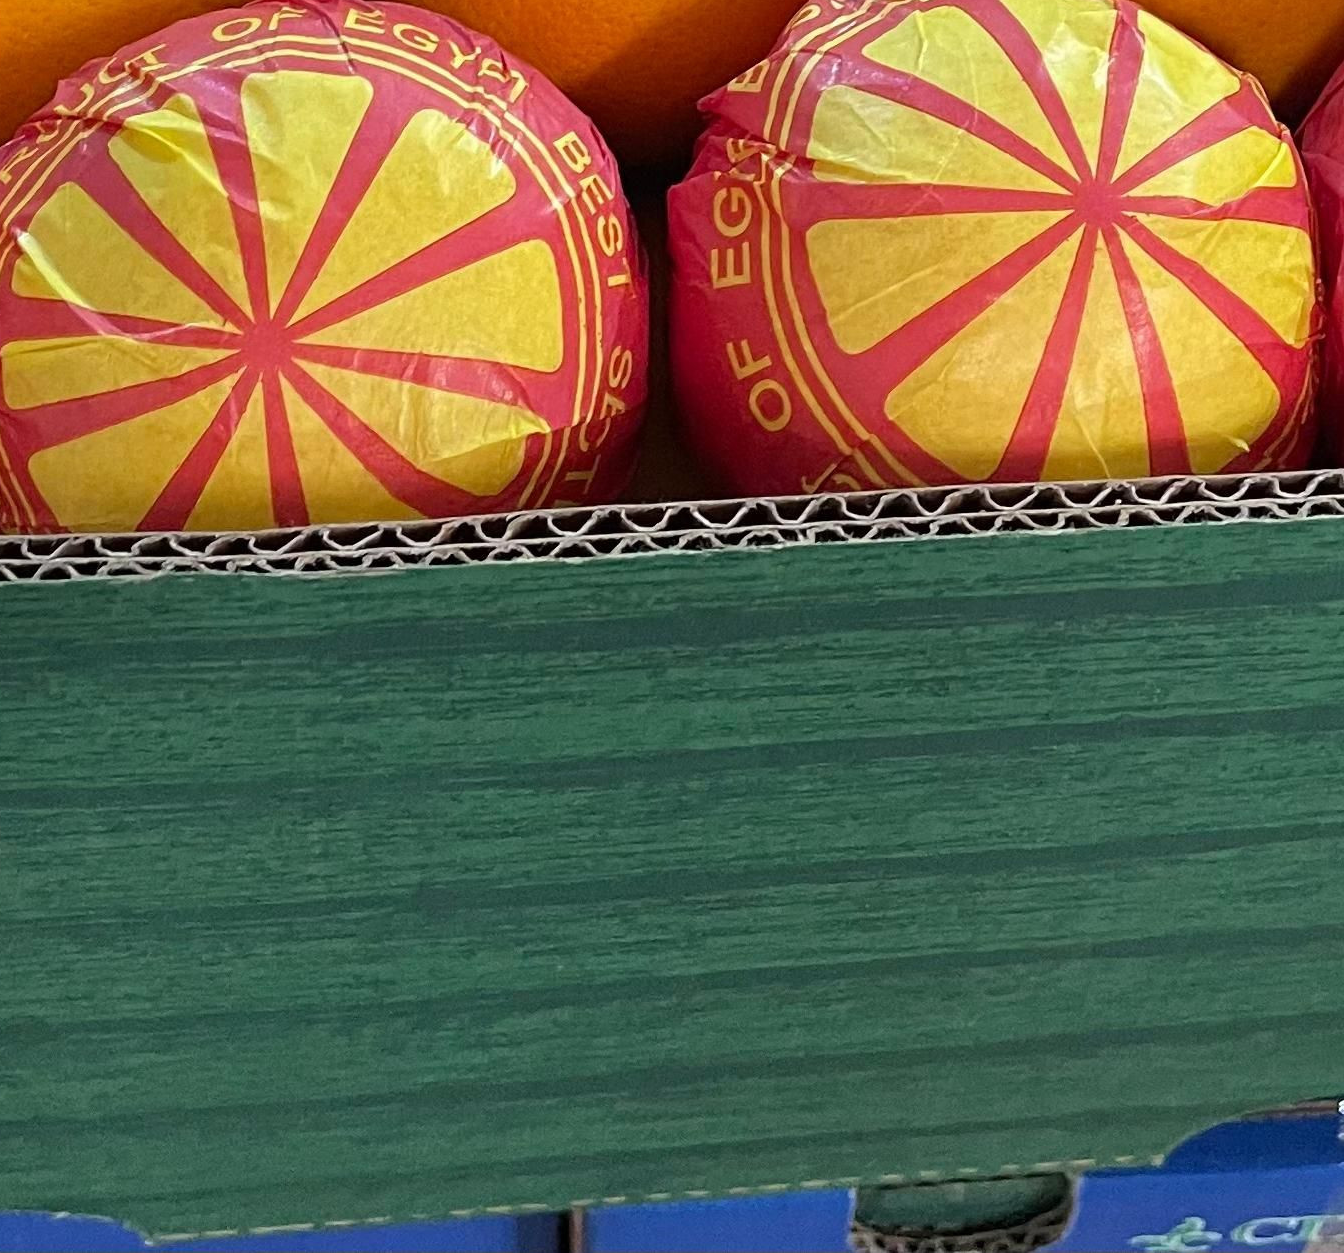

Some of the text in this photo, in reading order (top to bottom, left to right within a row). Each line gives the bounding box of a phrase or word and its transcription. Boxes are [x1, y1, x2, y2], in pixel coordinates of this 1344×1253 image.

[212, 6, 306, 42] OF
[553, 131, 636, 300] BEST
[727, 339, 792, 432] OF
